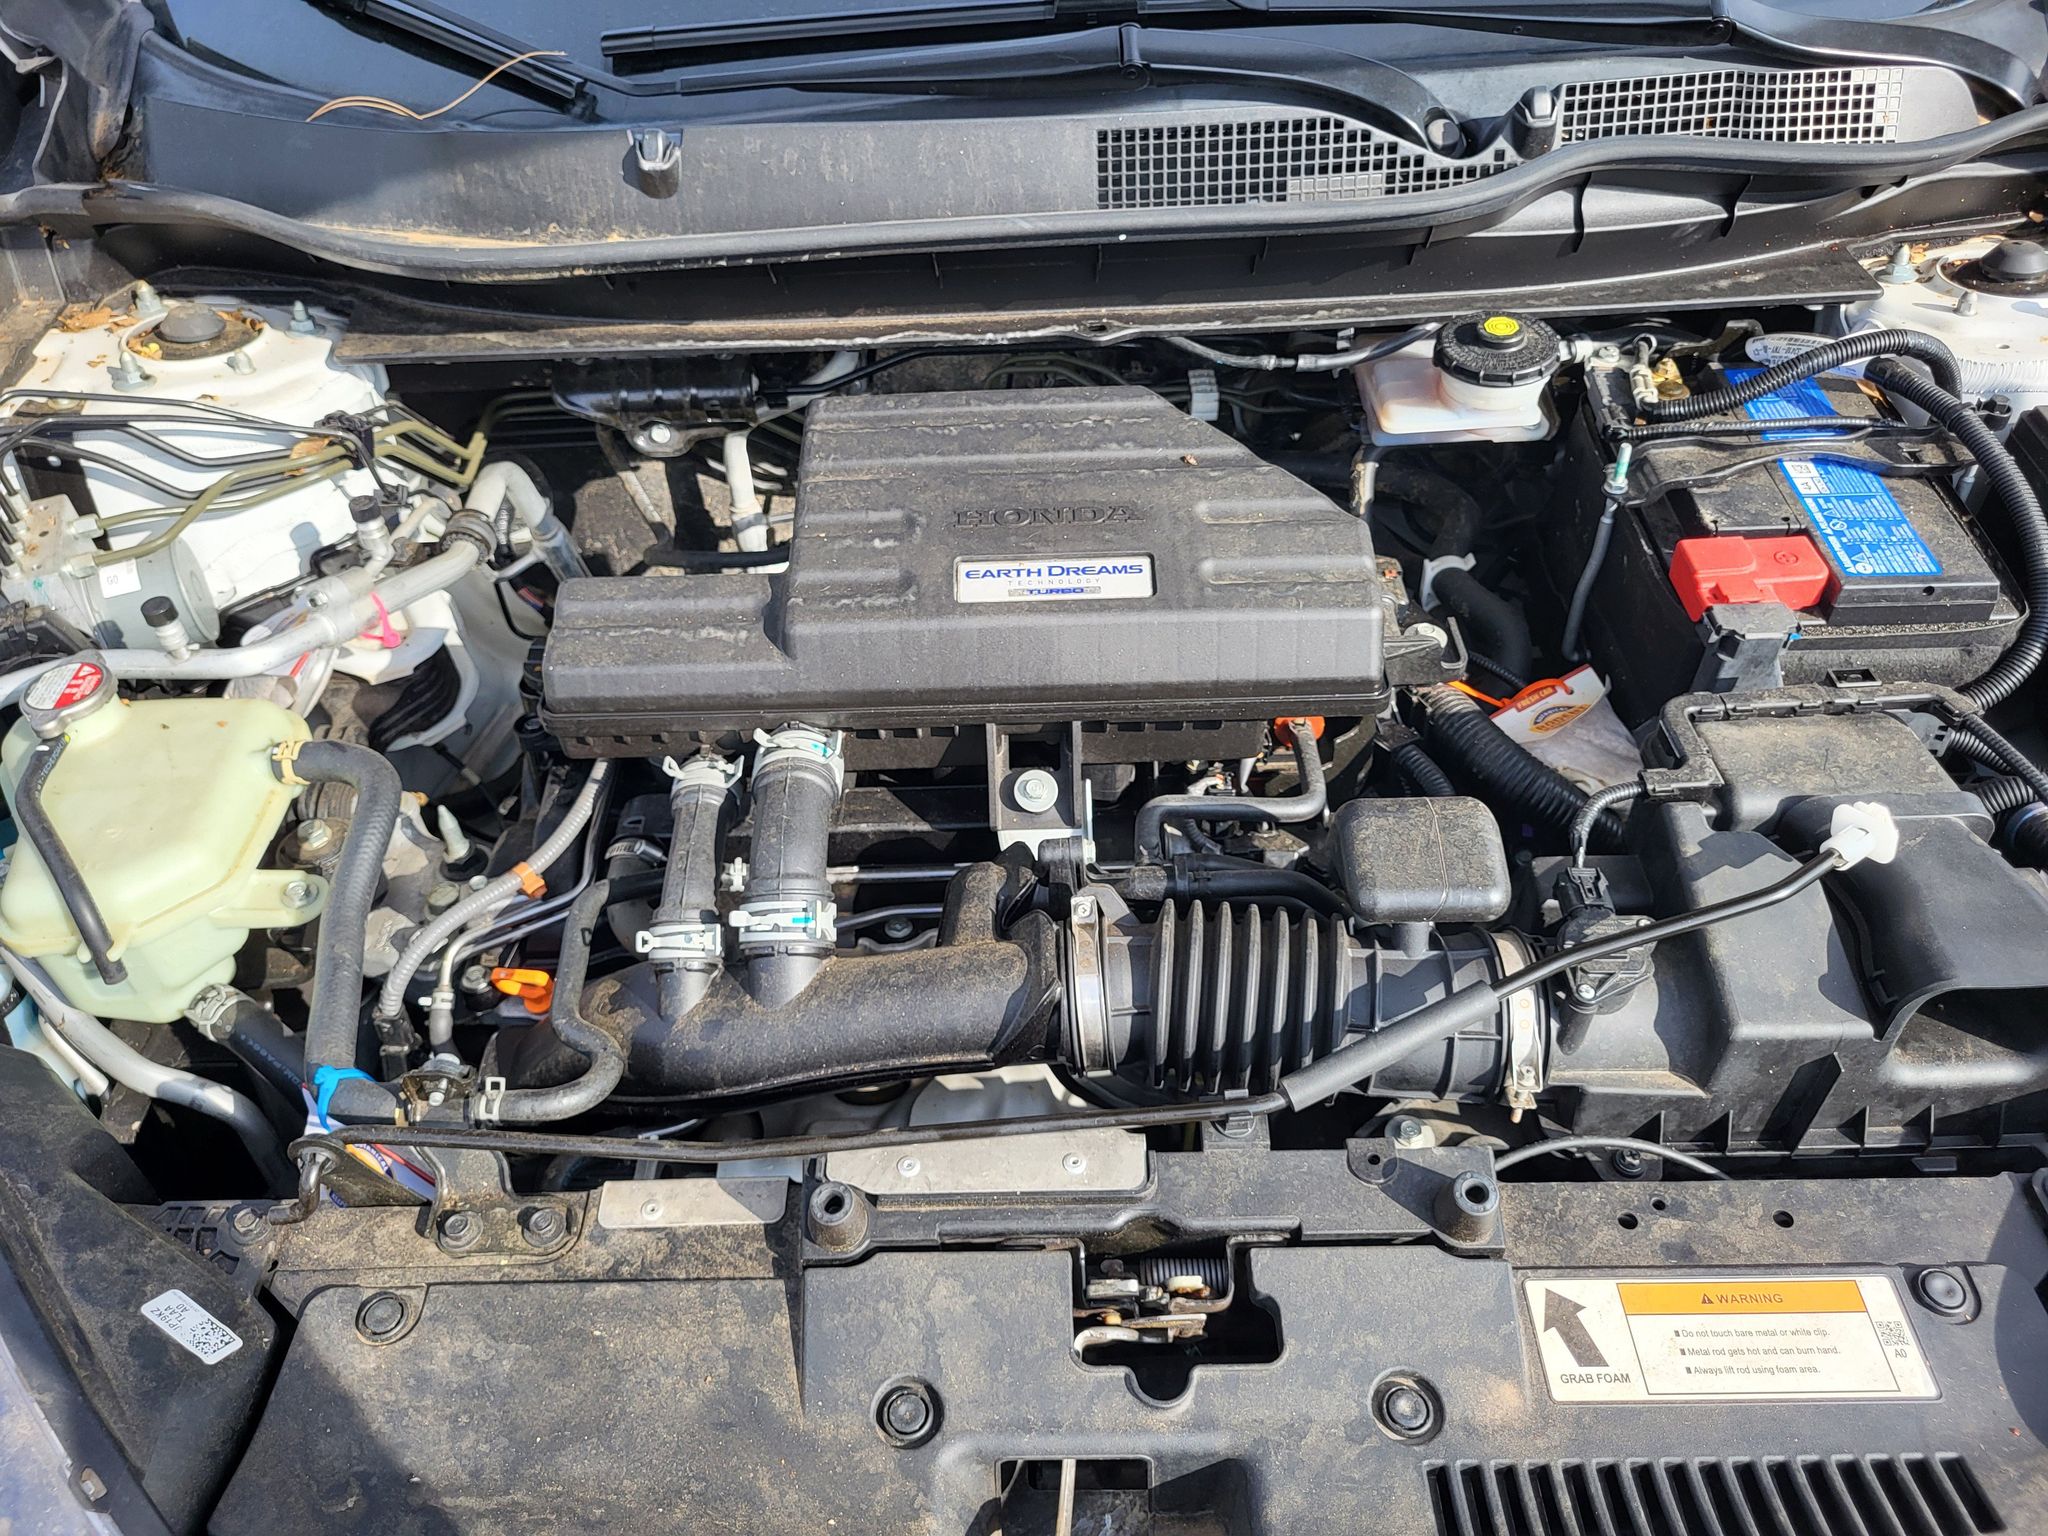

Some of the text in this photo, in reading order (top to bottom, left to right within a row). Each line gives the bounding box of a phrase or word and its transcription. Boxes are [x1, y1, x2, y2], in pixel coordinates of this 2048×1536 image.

[953, 505, 1146, 528] HONDA
[965, 564, 1144, 579] EARTH DREAMS
[1008, 578, 1100, 586] TECHNOLOGY
[1027, 587, 1084, 595] TURBO
[1716, 1294, 1783, 1304] WARNING
[1682, 1329, 1694, 1338] Do
[1696, 1330, 1709, 1338] not
[1711, 1329, 1734, 1337] touch
[1735, 1329, 1753, 1337] bare
[1756, 1328, 1778, 1337] metal
[1790, 1328, 1812, 1336] white
[1814, 1328, 1830, 1337] clip.
[1688, 1347, 1710, 1356] Metal
[1728, 1348, 1745, 1357] gets
[1747, 1347, 1760, 1355] hot
[1762, 1347, 1778, 1355] and
[1817, 1346, 1841, 1354] hand.
[1694, 1366, 1723, 1375] Always
[1724, 1366, 1735, 1374] lift
[1737, 1366, 1750, 1374] rod
[1752, 1366, 1775, 1375] using
[1560, 1373, 1632, 1384] GRAB FOAM
